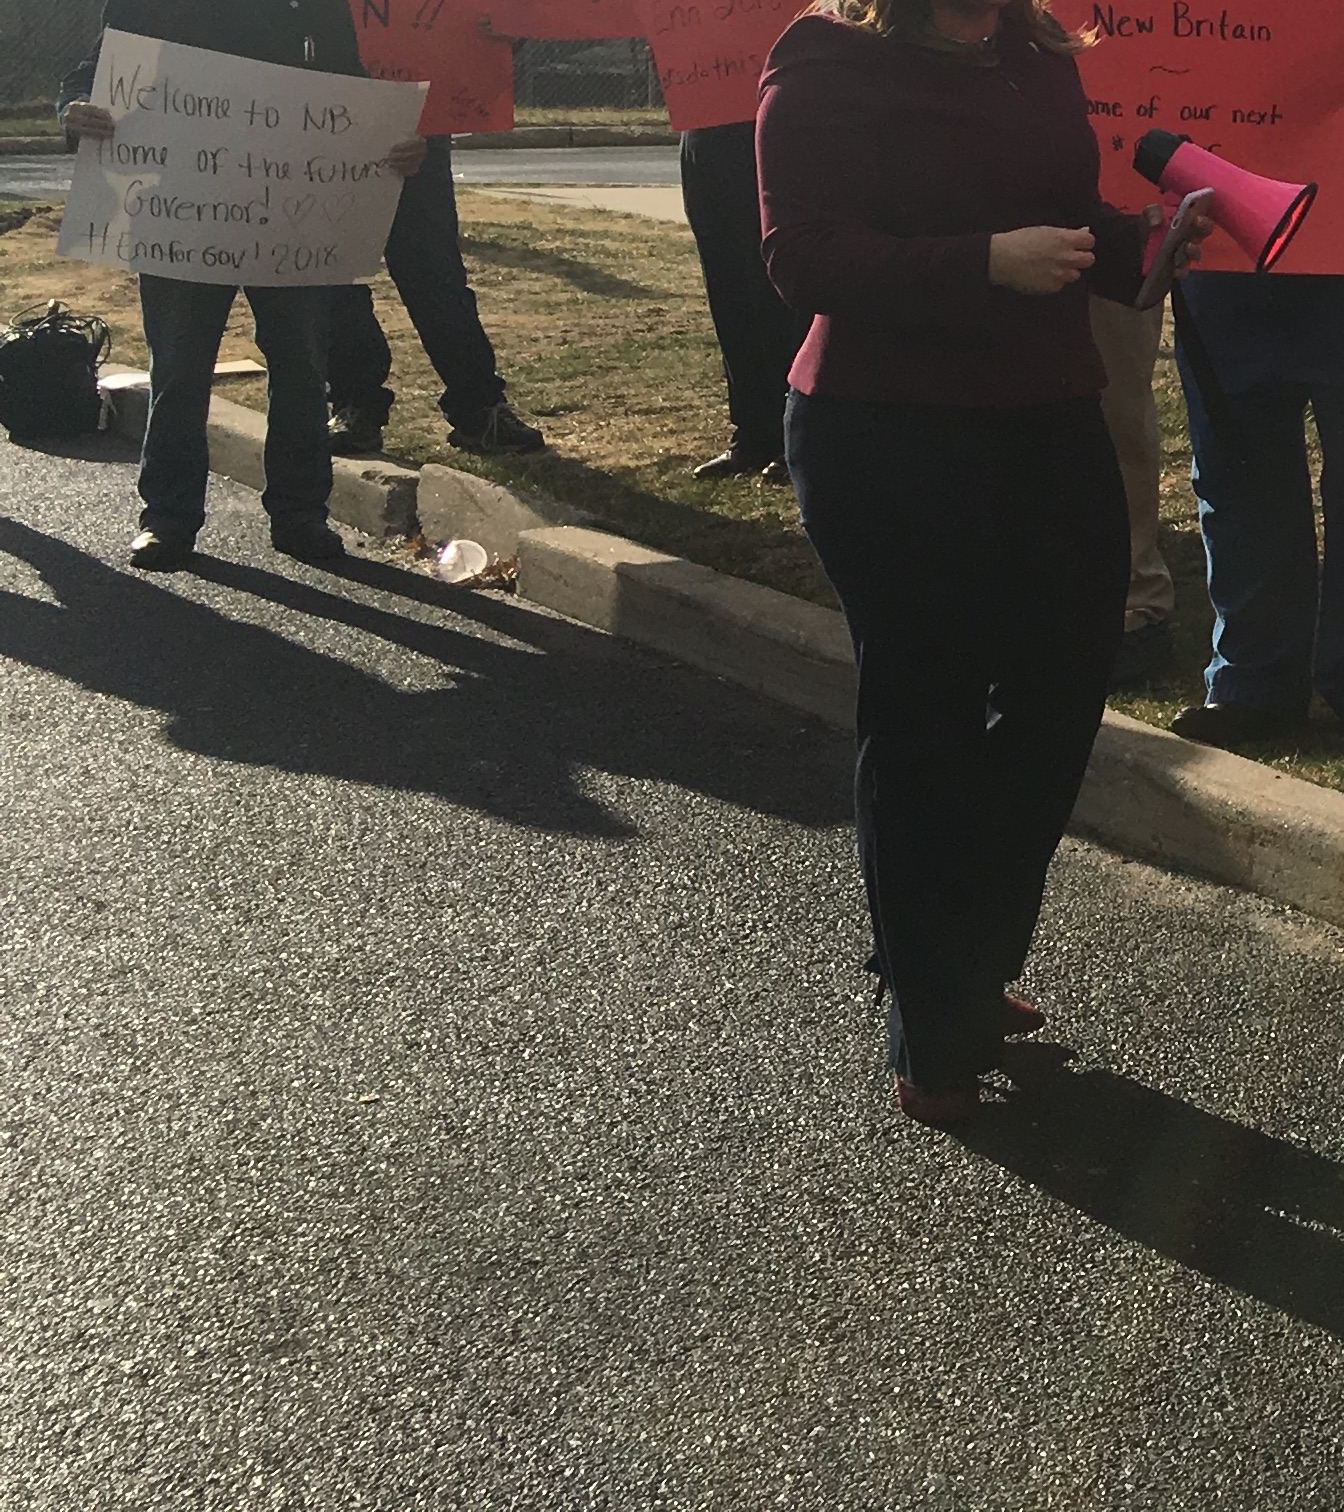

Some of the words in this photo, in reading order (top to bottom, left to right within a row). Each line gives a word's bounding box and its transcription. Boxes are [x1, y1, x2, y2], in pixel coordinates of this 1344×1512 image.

[1092, 3, 1154, 38] New
[1173, 1, 1272, 42] Britain
[108, 63, 232, 120] Welcome
[243, 97, 281, 129] to
[301, 101, 353, 135] NB
[1086, 98, 1123, 118] ome
[1136, 94, 1161, 120] of
[1180, 103, 1217, 122] our
[1231, 103, 1284, 126] next
[237, 153, 291, 180] the
[124, 180, 271, 226] Governor!
